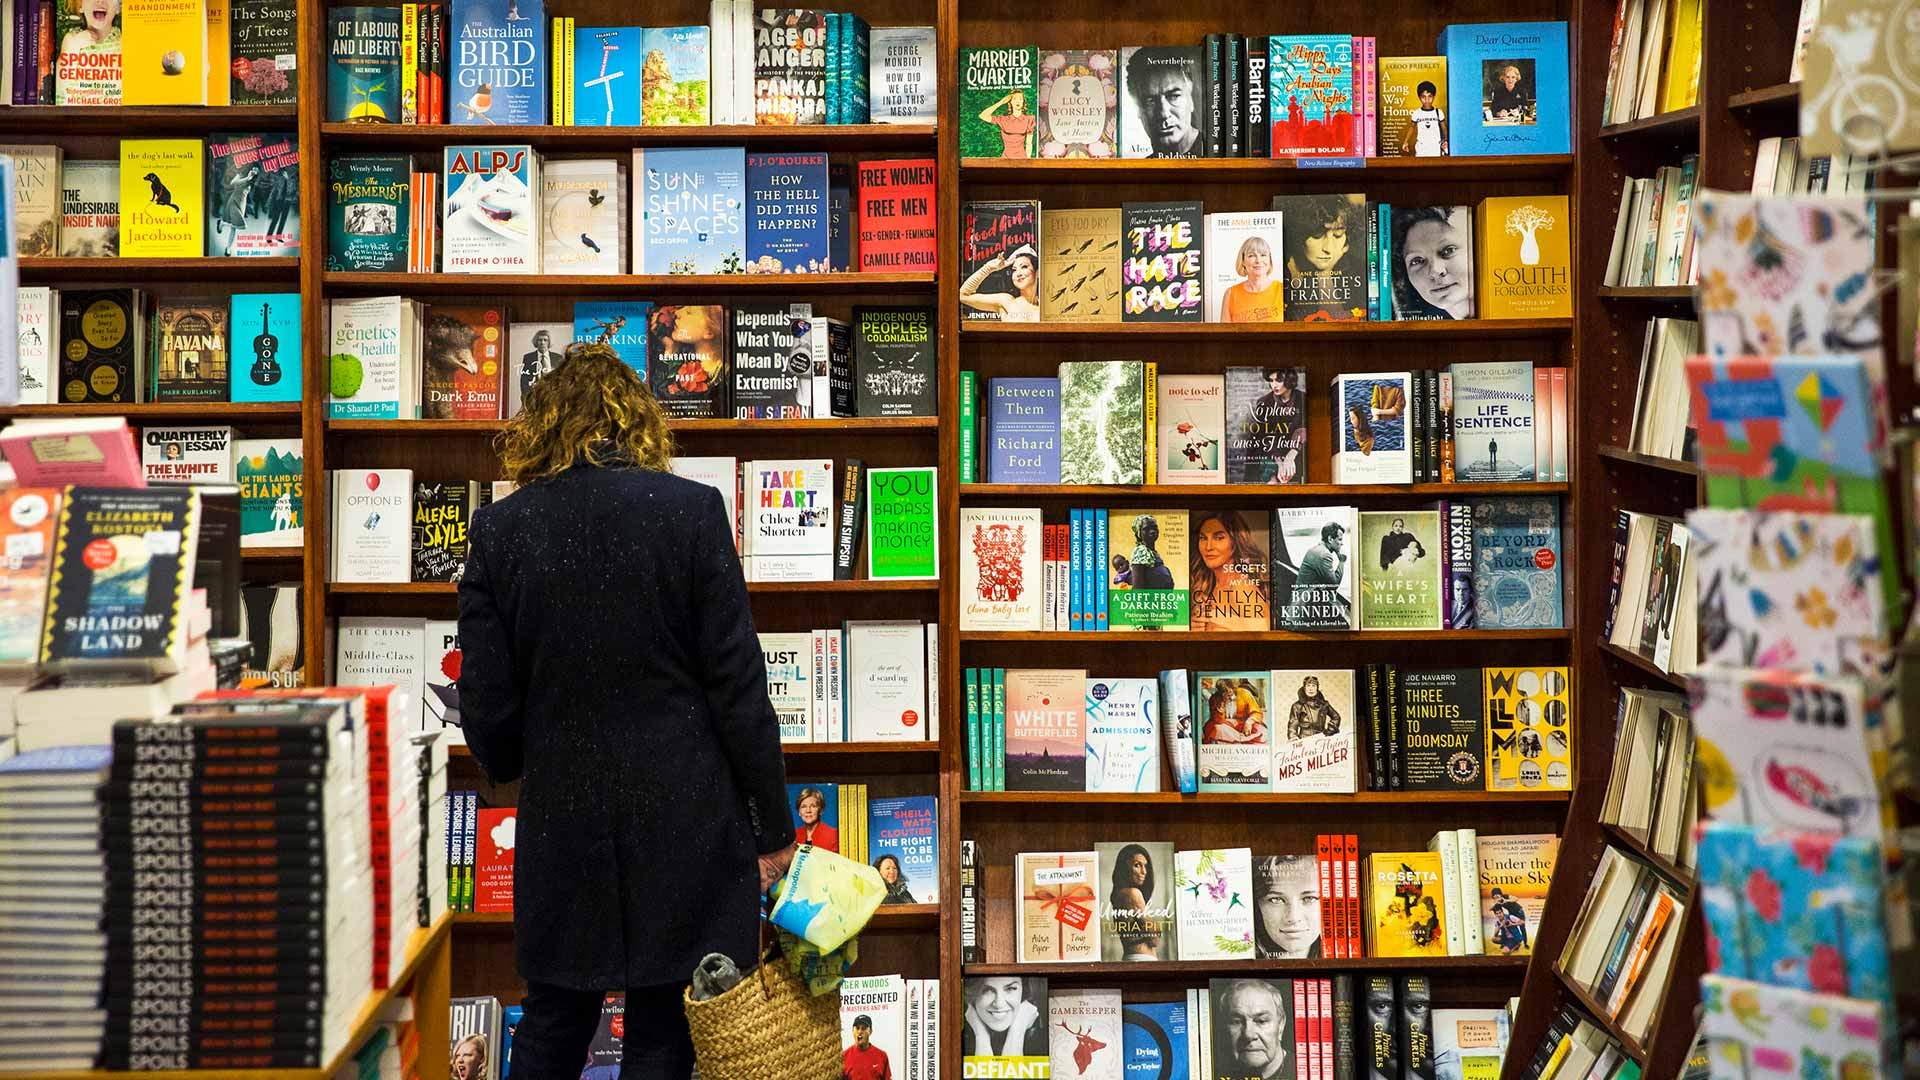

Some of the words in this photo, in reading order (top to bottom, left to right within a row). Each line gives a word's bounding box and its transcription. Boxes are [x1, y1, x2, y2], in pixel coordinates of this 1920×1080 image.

[233, 7, 259, 20] The
[261, 7, 297, 21] Songs
[238, 25, 252, 39] of
[255, 25, 289, 37] Trees
[338, 21, 351, 36] OF
[355, 21, 399, 37] LABOUR
[461, 24, 533, 38] Australian
[758, 28, 796, 47] AGE
[332, 39, 356, 56] AND
[460, 41, 536, 66] BIRD
[887, 45, 919, 56] GEORGE
[758, 49, 825, 67] ANGER
[884, 57, 922, 67] MONBIOT
[969, 49, 1029, 68] MARRIED
[1147, 57, 1194, 66] Nevertheless
[458, 69, 535, 87] GUIDE
[886, 73, 905, 82] HOW
[908, 72, 921, 82] DID
[967, 68, 1032, 85] QUARTER
[1382, 72, 1390, 81] A
[889, 84, 901, 93] WE
[904, 83, 918, 92] GET
[1249, 58, 1266, 124] Barthes
[1383, 83, 1409, 96] Long
[882, 95, 903, 105] INTO
[905, 95, 925, 104] THIS
[1062, 97, 1091, 105] LUCY
[1382, 95, 1404, 107] Way
[890, 107, 917, 117] MESS?
[1052, 107, 1102, 116] WORSLEY
[1383, 106, 1413, 116] Home
[127, 152, 141, 160] the
[142, 152, 161, 161] dog's
[163, 151, 175, 160] last
[177, 151, 195, 160] walk
[350, 165, 371, 174] Wendy
[449, 151, 526, 175] ALPS
[650, 171, 699, 190] SUN
[771, 175, 802, 185] HOW
[860, 170, 887, 188] FREE
[890, 168, 933, 185] WOMEN
[333, 183, 408, 203] MESMERIST
[754, 191, 782, 200] THE
[786, 190, 820, 200] HELL
[649, 193, 724, 213] SHINE
[867, 201, 895, 217] FREE
[901, 198, 928, 216] MEN
[757, 206, 783, 216] DID
[788, 204, 817, 215] THIS
[132, 212, 189, 226] Howard
[650, 216, 740, 234] SPACES
[758, 219, 817, 230] HAPPEN?
[125, 228, 192, 245] Jacobson
[1132, 222, 1193, 251] THE
[451, 257, 488, 265] STEPHEN
[492, 256, 524, 265] O'SHEA
[863, 253, 900, 266] CAMILLE
[904, 252, 935, 265] PAGLIA
[1128, 250, 1201, 284] HATE
[1493, 267, 1567, 286] SOUTH
[1130, 280, 1201, 310] RACE
[1290, 288, 1351, 301] FRANCE
[1494, 285, 1567, 296] FORGIVENESS
[737, 311, 791, 327] Depends
[862, 312, 927, 322] INDIGENOUS
[862, 322, 927, 335] PEOPLES
[335, 326, 397, 345] genetics
[736, 331, 767, 347] What
[770, 332, 794, 347] You
[867, 333, 927, 342] COLONIALISM
[164, 334, 222, 351] HAVANA
[361, 341, 396, 357] health
[736, 353, 771, 369] Mean
[774, 353, 788, 371] By
[736, 375, 798, 390] Extremist
[431, 391, 463, 402] Dark
[467, 391, 496, 401] Emu
[996, 385, 1055, 398] Between
[1168, 387, 1189, 397] note
[1191, 387, 1201, 396] to
[1202, 386, 1220, 396] self
[1005, 402, 1045, 415] Them
[1477, 405, 1509, 416] LIFE
[1455, 417, 1531, 428] SENTENCE
[146, 430, 228, 446] QUARTERLY
[997, 437, 1053, 450] Richard
[185, 440, 228, 452] ESSAY
[1009, 455, 1042, 468] Ford
[146, 464, 173, 474] THE
[174, 463, 218, 474] WHITE
[252, 475, 267, 483] THE
[269, 475, 291, 483] LAND
[759, 470, 805, 488] TAKE
[873, 474, 930, 497] YOU
[240, 483, 304, 498] GIANTS
[760, 490, 818, 508] HEART
[415, 503, 460, 525] ALEXEI
[843, 504, 854, 527] JOHN
[874, 502, 930, 516] BADASS
[760, 513, 795, 525] Chloe
[759, 526, 806, 537] Shorten
[1072, 519, 1080, 538] MARK
[1451, 506, 1463, 561] NIXON
[1463, 506, 1472, 560] RICHARD
[424, 522, 467, 550] SAYLE
[839, 527, 853, 568] SIMPSON
[1072, 538, 1080, 569] HOLDEN
[1223, 564, 1267, 573] SECRETS
[1373, 580, 1429, 590] WIFE'S
[1123, 594, 1151, 602] GIFT
[1153, 592, 1186, 601] FROM
[1193, 590, 1267, 604] CAITLYN
[1291, 590, 1339, 602] BOBBY
[1374, 593, 1428, 604] HEART
[1120, 601, 1179, 610] DARKNESS
[1197, 604, 1264, 618] JENNER
[1281, 605, 1348, 618] KENNEDY
[64, 614, 164, 631] SHADOW
[81, 634, 143, 649] LAND
[344, 651, 415, 660] Middle-Class
[345, 665, 413, 675] Constitution
[1406, 690, 1443, 702] THREE
[1406, 705, 1459, 718] MINUTES
[1013, 711, 1078, 728] WHITE
[1014, 728, 1078, 737] BUTTERFLIES
[1092, 727, 1152, 735] ADMISSIONS
[1406, 720, 1420, 733] TO
[134, 727, 194, 741] SPOILS
[1407, 734, 1468, 748] DOOMSDAY
[1279, 763, 1303, 780] MRS
[1307, 749, 1348, 770] MILLER
[878, 839, 898, 847] THE
[900, 837, 933, 846] RIGHT
[903, 846, 917, 855] TO
[919, 845, 933, 854] BE
[904, 855, 933, 864] COLD
[1484, 859, 1528, 870] Under
[1530, 859, 1551, 869] the
[1378, 871, 1438, 882] ROSETTA
[1480, 873, 1524, 885] Same
[963, 898, 976, 947] OPERATOR
[132, 926, 192, 942] SPOILS
[1050, 1007, 1117, 1015] GAMEKEEPER
[963, 1062, 1050, 1079] DEFIANT
